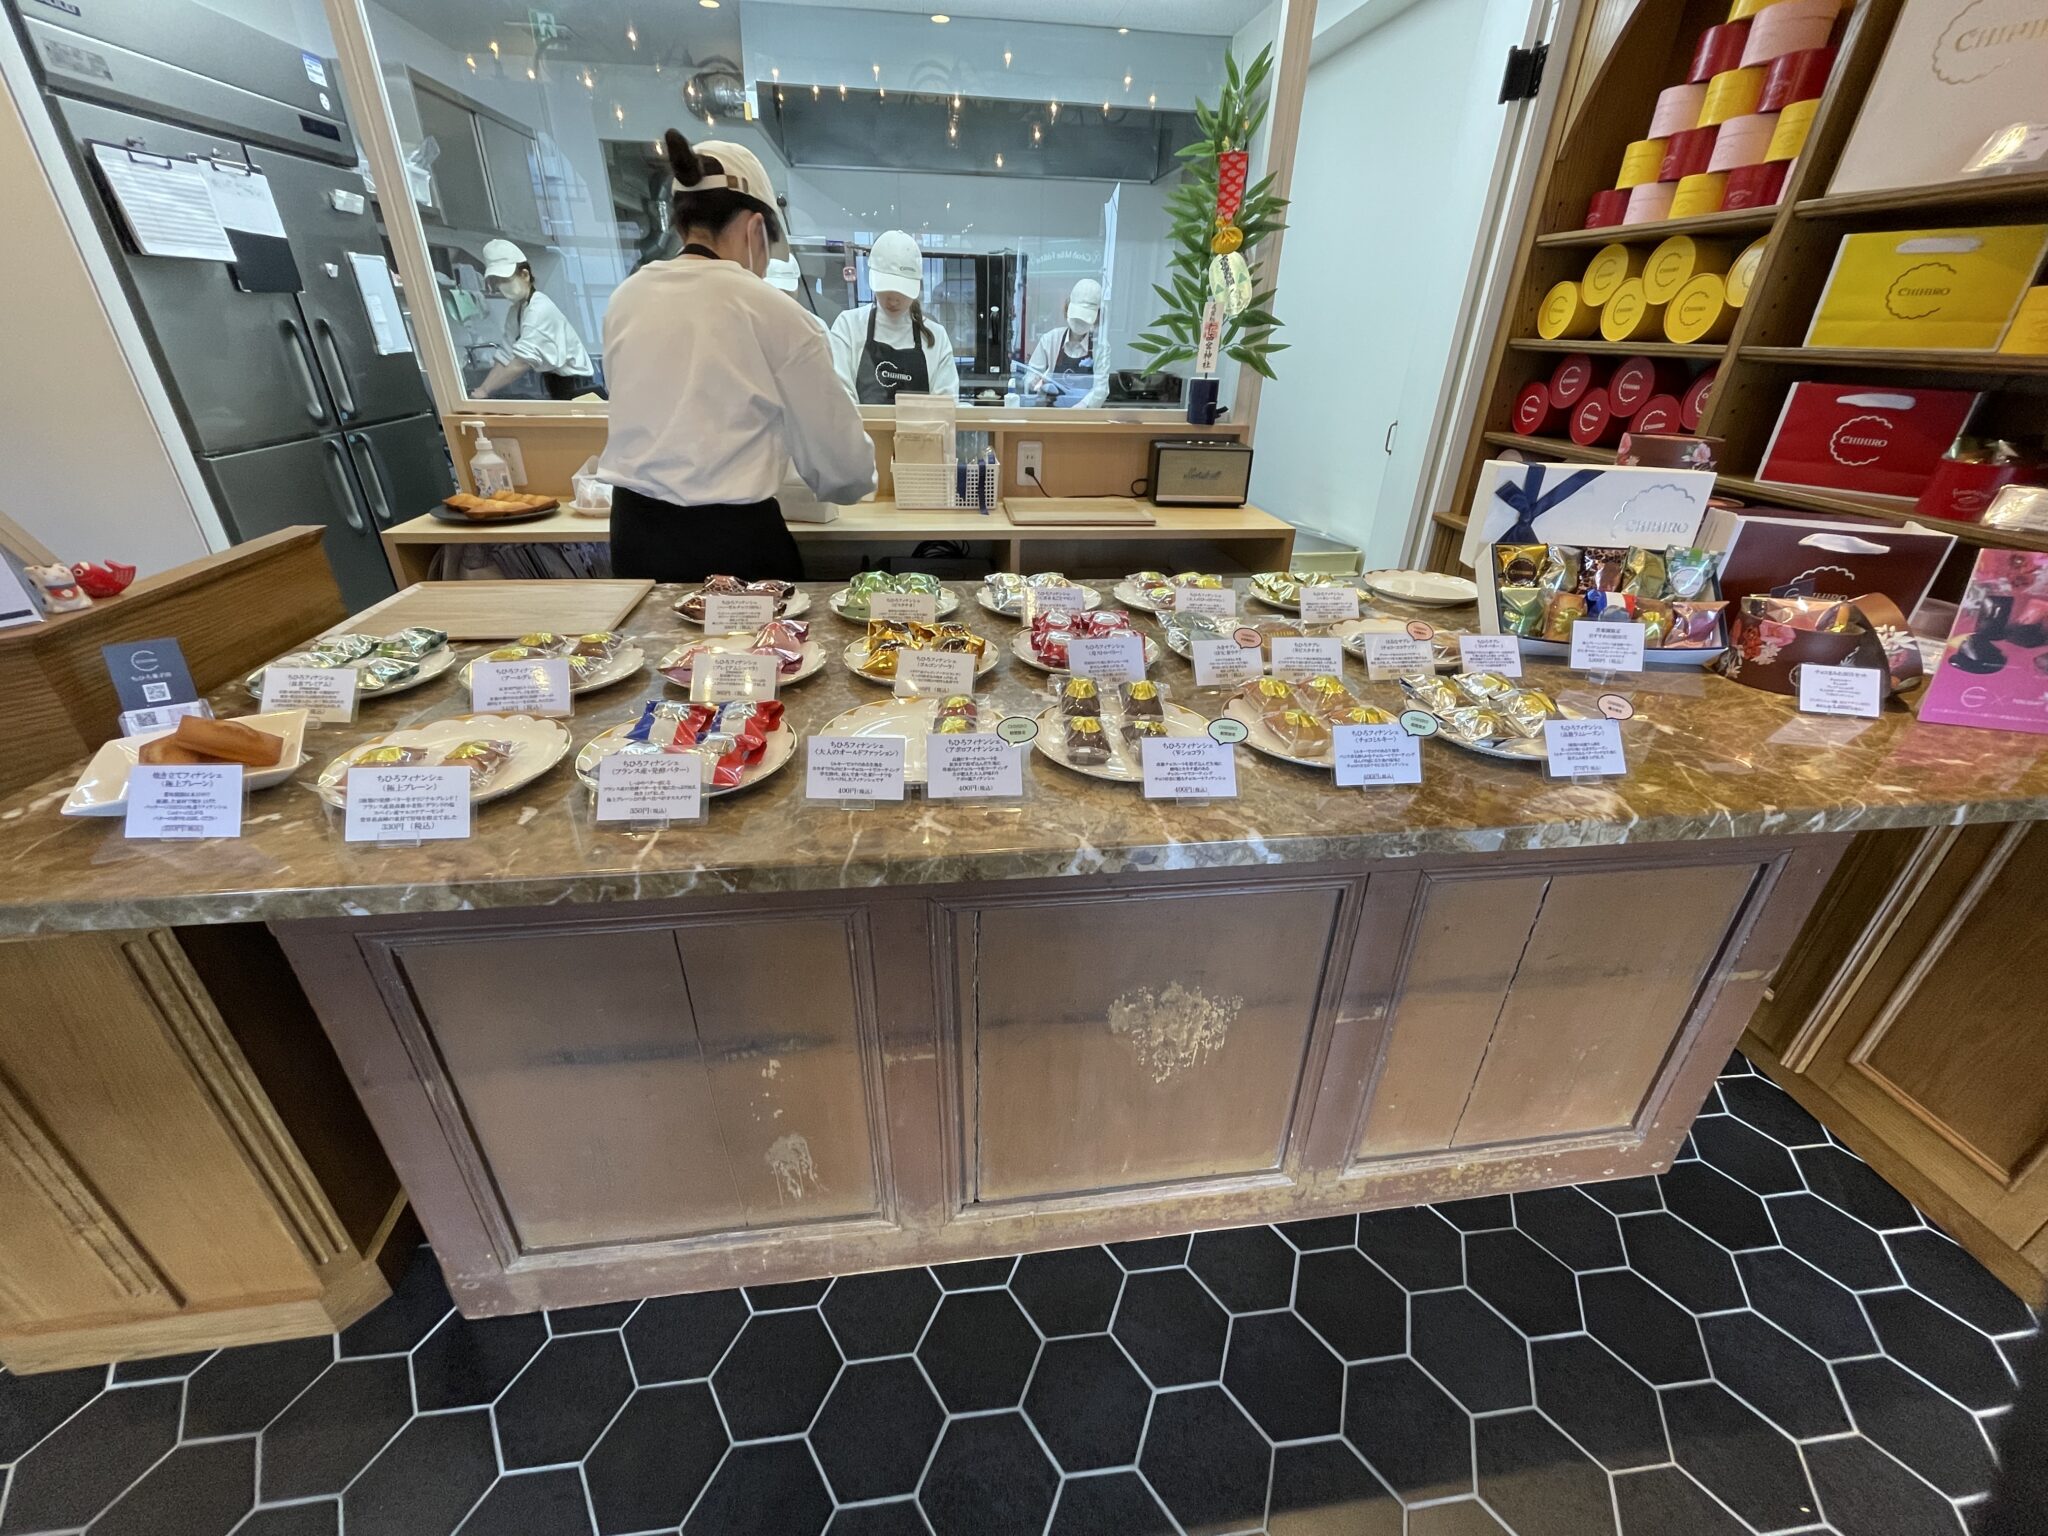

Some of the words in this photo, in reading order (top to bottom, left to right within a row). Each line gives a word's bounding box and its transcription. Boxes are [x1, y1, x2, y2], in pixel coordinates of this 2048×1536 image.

[1898, 288, 1950, 296] CHIHIRO
[882, 370, 912, 381] CHIHIRO
[1840, 435, 1888, 448] CHIHIRO
[1625, 520, 1689, 533] CHIHIRO
[916, 655, 957, 664] ちひろフィナンシェ
[1351, 729, 1399, 737] ちひろフィナンシェ
[830, 741, 885, 749] ちひろフィナンシェ
[945, 745, 1004, 753] （アポロフィナンシェ）
[1162, 742, 1214, 750] ちひろフィナンシェ
[814, 748, 900, 757] （大人のオールドファッション）
[612, 766, 690, 776] （フランス産・発酵バター）
[376, 774, 445, 783] ちひろフィナンシェ
[160, 780, 214, 788] （極上プレーン）
[381, 783, 438, 792] （極上プレーン）
[410, 822, 436, 830] （税込）
